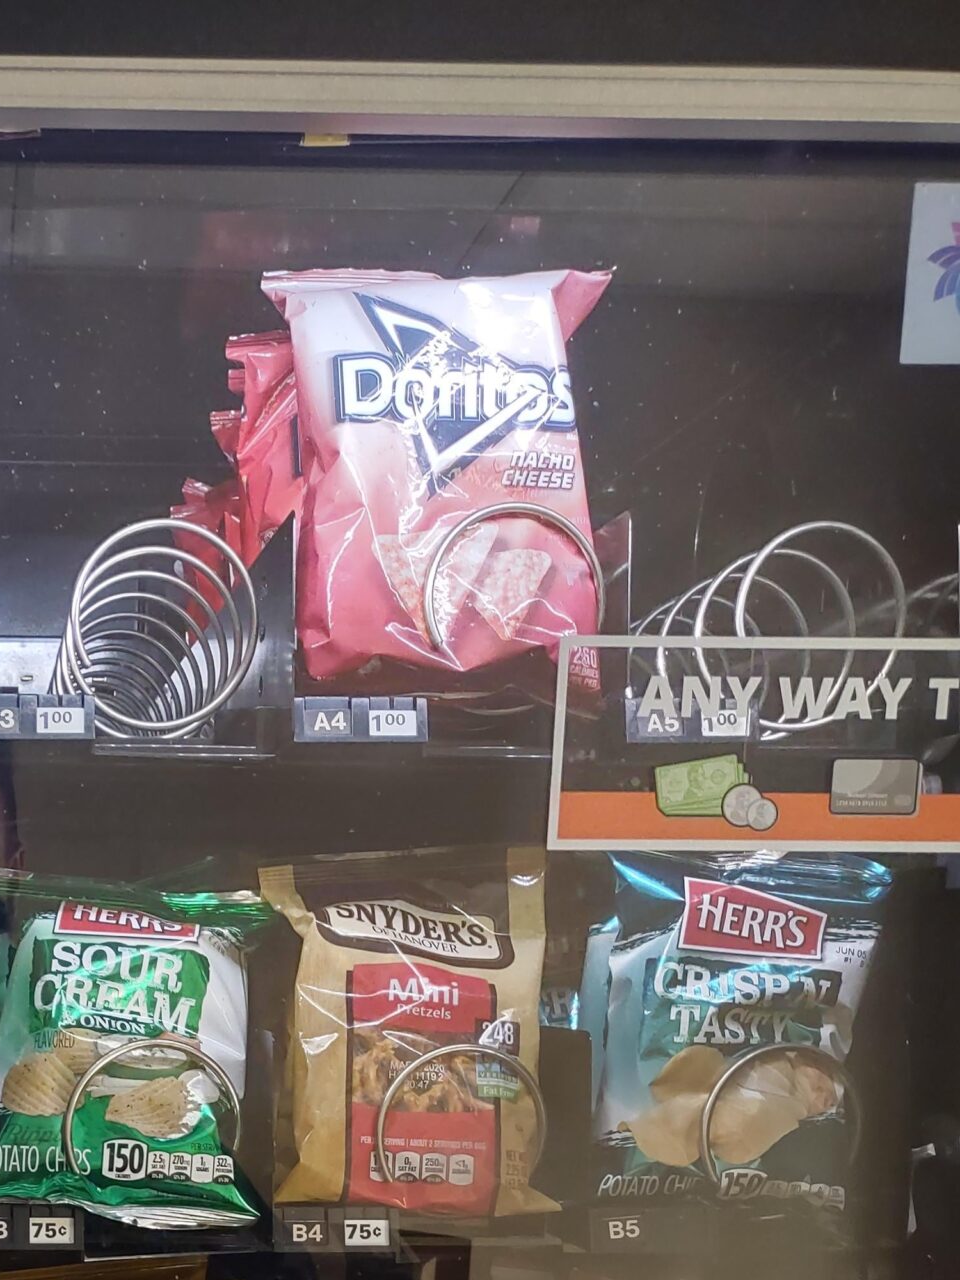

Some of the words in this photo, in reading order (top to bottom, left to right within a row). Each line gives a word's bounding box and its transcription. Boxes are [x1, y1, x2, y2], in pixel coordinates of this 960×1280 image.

[337, 354, 575, 428] Doritos
[510, 450, 575, 471] NACHO
[501, 470, 574, 490] CHEESE
[638, 675, 762, 718] ANY
[778, 676, 913, 720] WAY
[313, 712, 347, 731] A4
[647, 713, 680, 733] A5
[336, 904, 490, 948] SNYDER'S
[697, 894, 808, 949] HERR'S
[390, 928, 459, 954] HANOVER
[836, 946, 855, 957] JUN
[51, 940, 183, 994] SOUR
[654, 961, 790, 1005] CRISP
[34, 974, 197, 1038] CREAM
[397, 1003, 452, 1021] Pretzels
[80, 1014, 146, 1034] ONION
[670, 1003, 796, 1045] TASTY
[46, 1146, 91, 1175] CHPS
[106, 1142, 144, 1174] 150
[597, 1174, 659, 1197] POTATO
[31, 1222, 68, 1239] 75¢
[292, 1223, 323, 1242] B4
[345, 1224, 382, 1241] 75¢
[608, 1220, 640, 1240] B5
